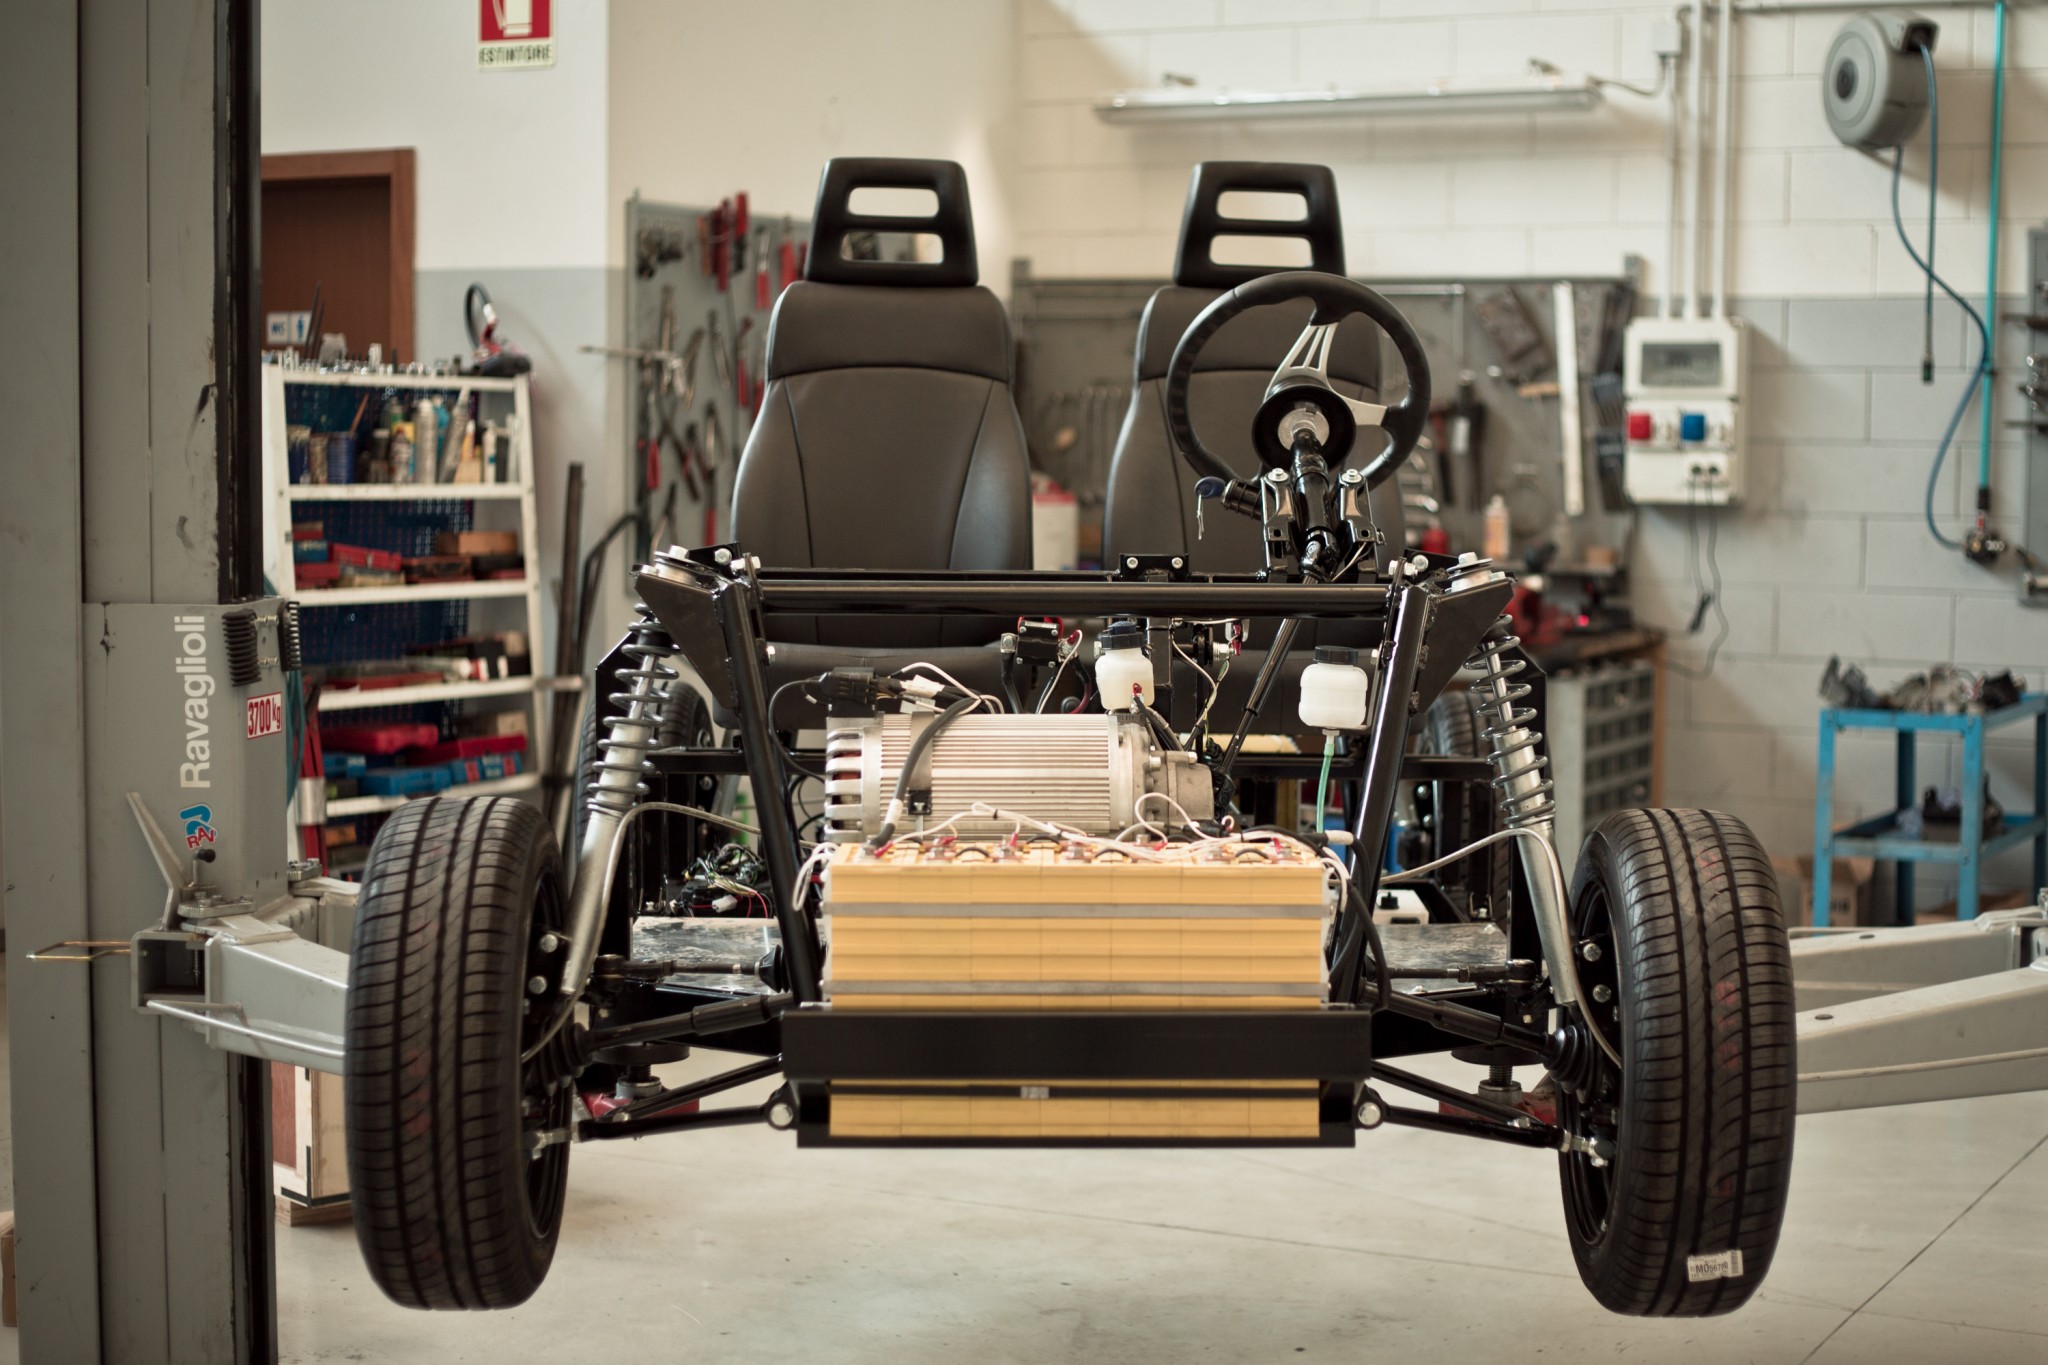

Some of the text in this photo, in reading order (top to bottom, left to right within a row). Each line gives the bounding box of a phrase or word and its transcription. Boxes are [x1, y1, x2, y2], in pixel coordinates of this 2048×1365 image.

[479, 45, 551, 65] ESTINTORE
[174, 616, 215, 788] Ravaglioli
[248, 697, 282, 736] 3700 kg
[187, 827, 215, 848] RAV
